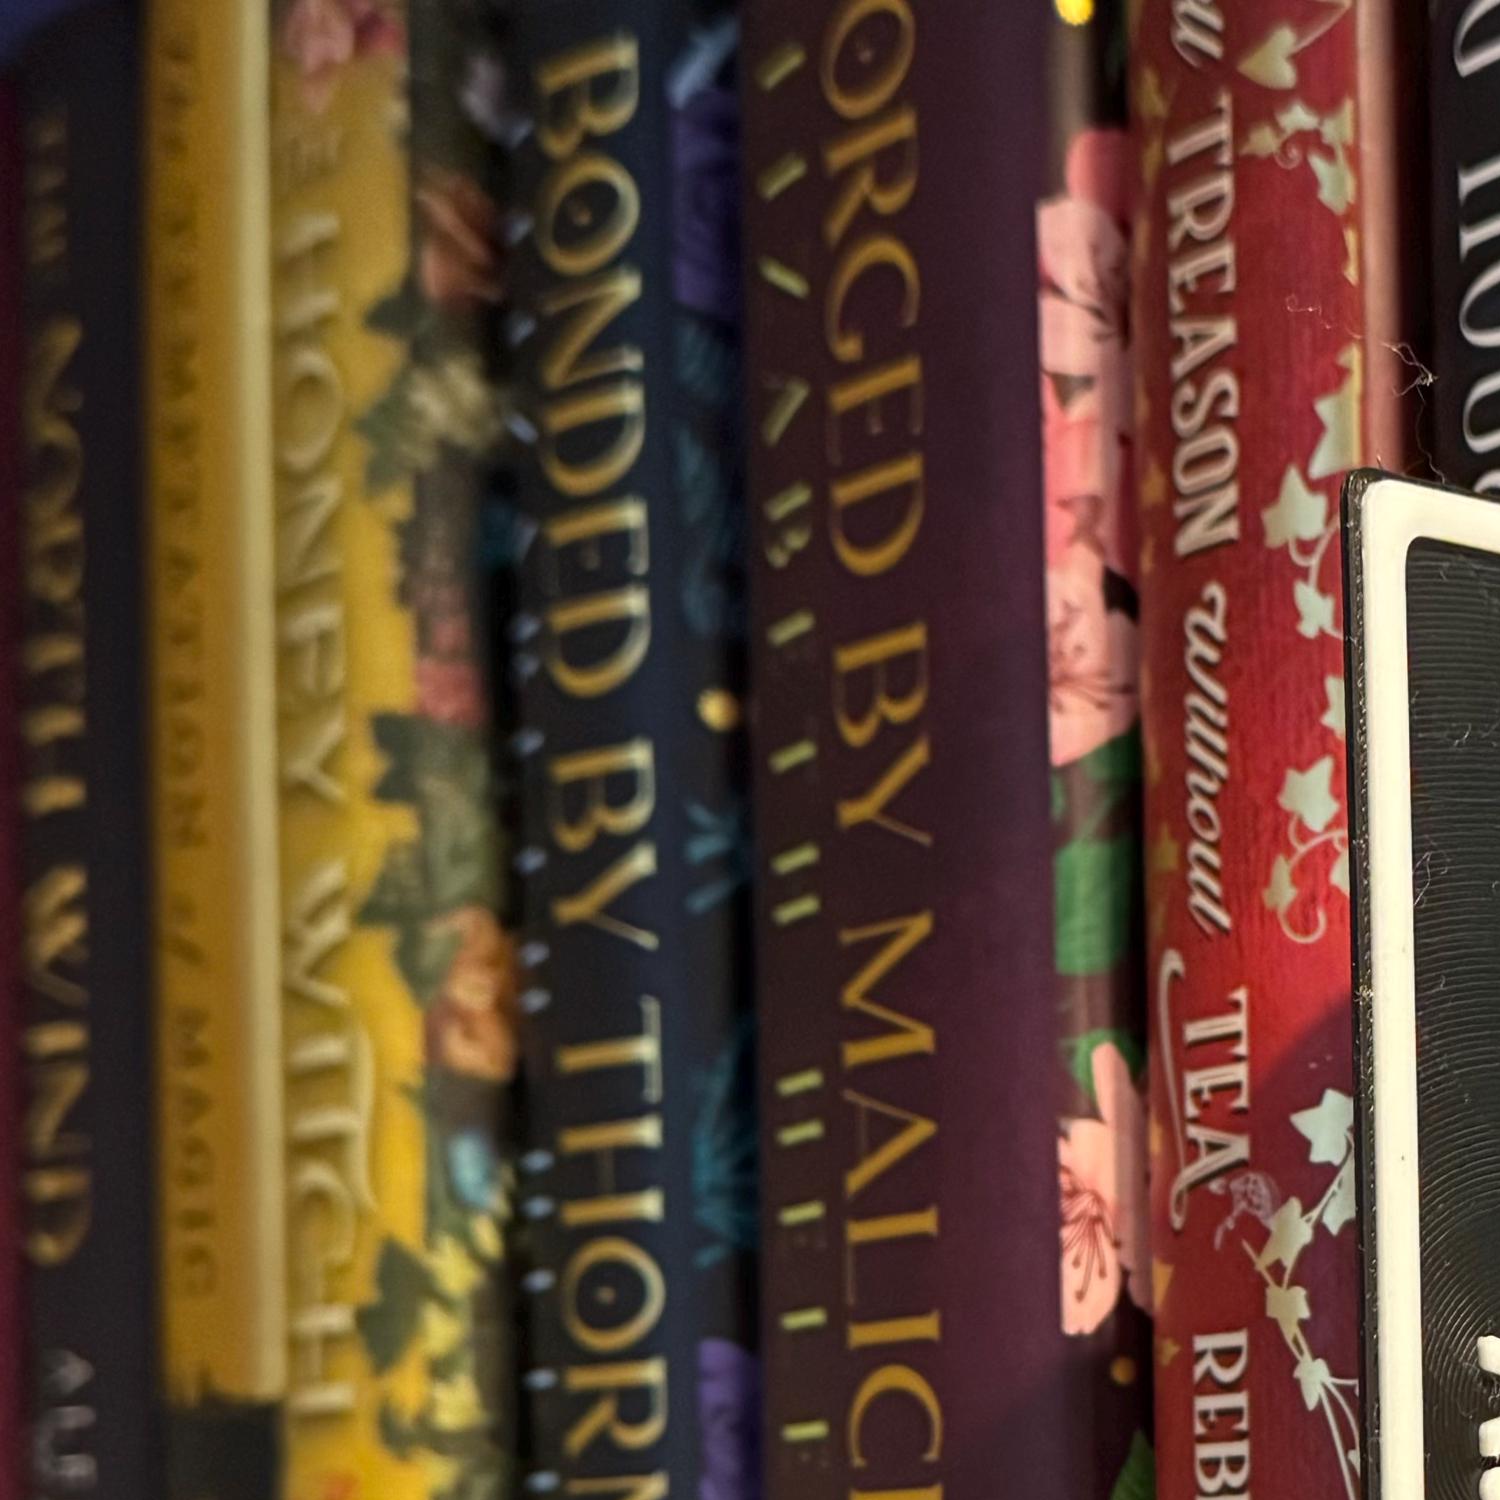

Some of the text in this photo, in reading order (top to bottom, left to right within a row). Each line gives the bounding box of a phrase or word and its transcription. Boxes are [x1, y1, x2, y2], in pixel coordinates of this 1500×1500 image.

[532, 33, 651, 698] BONDED
[1166, 93, 1240, 558] TREASON
[548, 737, 660, 950] BY
[832, 621, 932, 847] BY
[1158, 949, 1250, 1231] TEA
